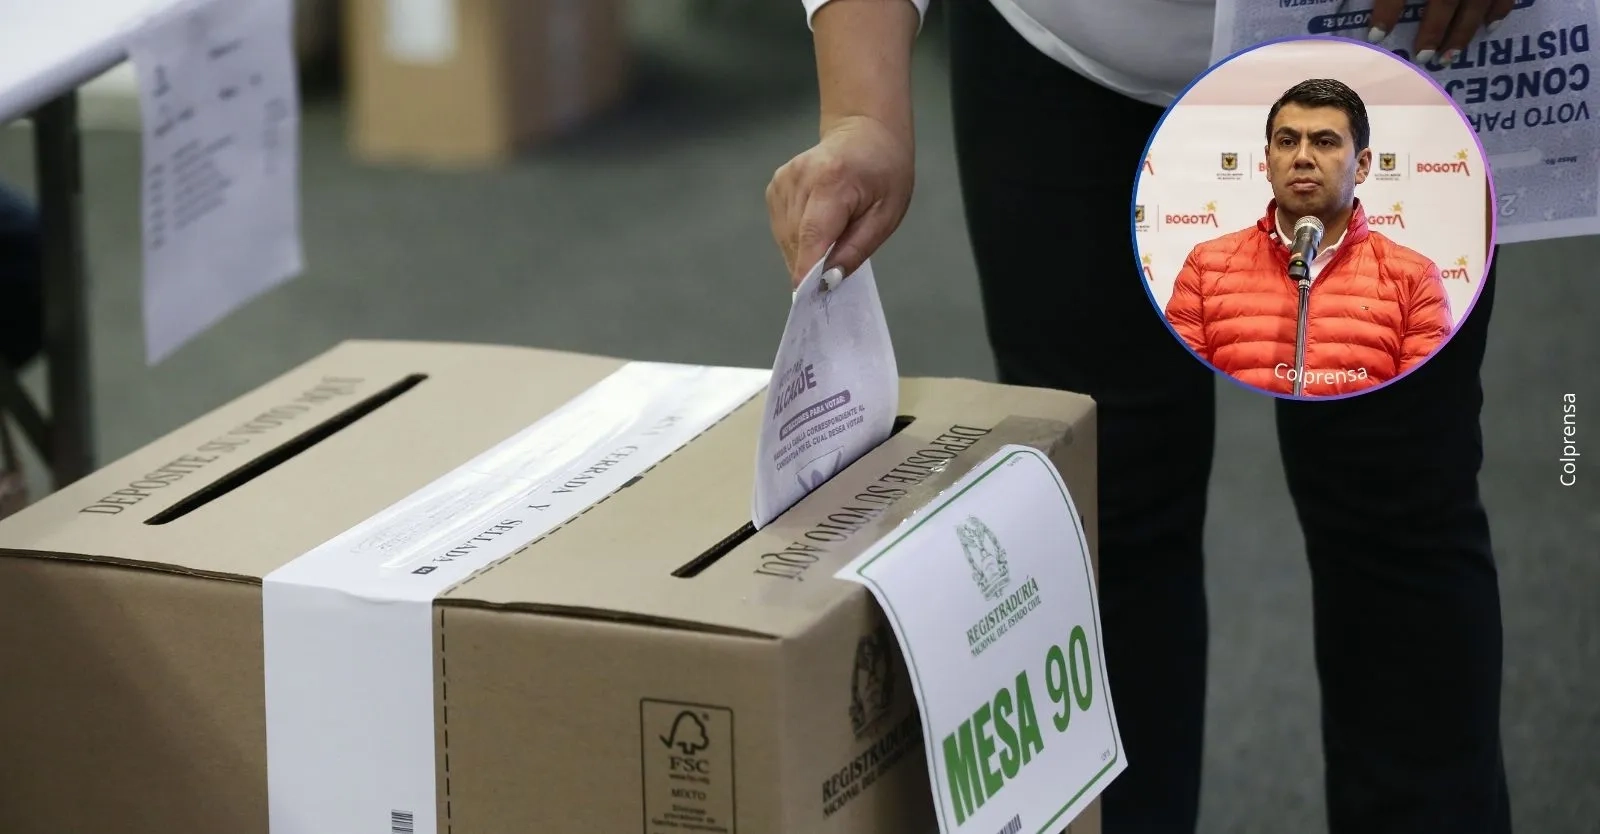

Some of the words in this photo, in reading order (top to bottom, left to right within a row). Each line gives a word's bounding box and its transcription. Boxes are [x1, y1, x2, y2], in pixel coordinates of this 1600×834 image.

[1445, 63, 1590, 104] CONCEJ
[1469, 110, 1516, 133] PAR
[1524, 101, 1590, 128] VOTO
[806, 406, 858, 437] CORRESPONDIENTE
[812, 433, 828, 445] CUAL
[828, 424, 846, 438] DESEA
[846, 415, 864, 429] VOTAR
[78, 453, 219, 515] DEPOSITE
[197, 436, 250, 453] SU
[227, 404, 310, 434] VOTO
[552, 445, 639, 494] CERRADA
[879, 424, 993, 486] DEPOSITE
[528, 503, 550, 511] Y
[855, 485, 908, 507] SU
[432, 518, 523, 563] SELLADA
[805, 506, 884, 542] VOTO
[966, 575, 1039, 647] REGISTRADURÍA
[971, 632, 997, 657] NACIONAL
[996, 623, 1009, 638] DEL
[1007, 606, 1028, 628] ESTADO
[1027, 595, 1042, 612] CIVIL
[942, 669, 1044, 827] MESA
[1045, 624, 1093, 733] 90
[668, 755, 711, 775] FSC
[671, 788, 707, 801] MIXTO
